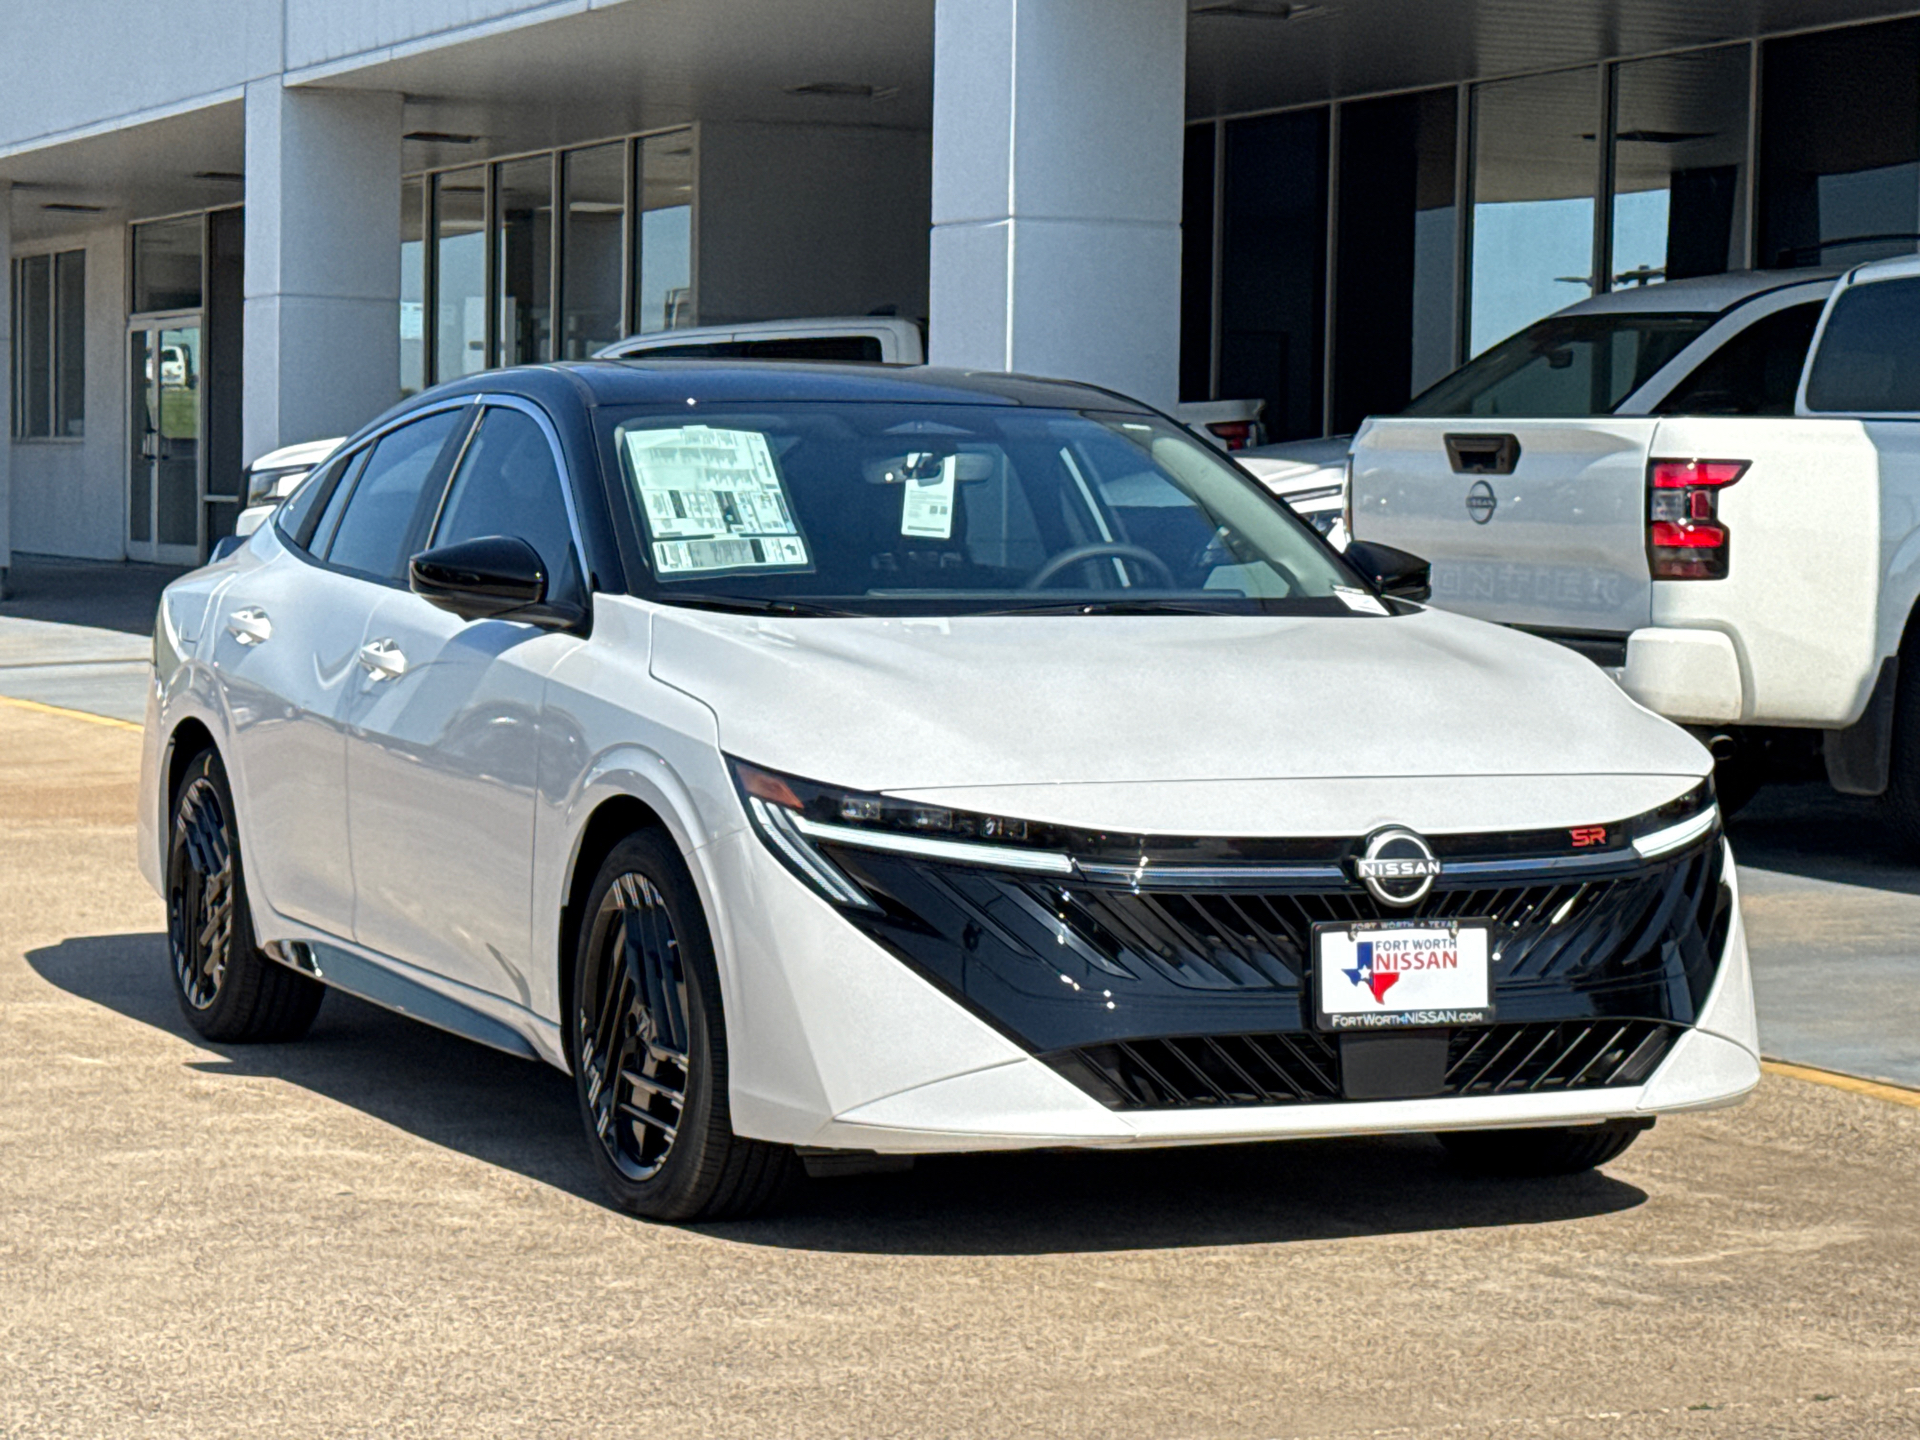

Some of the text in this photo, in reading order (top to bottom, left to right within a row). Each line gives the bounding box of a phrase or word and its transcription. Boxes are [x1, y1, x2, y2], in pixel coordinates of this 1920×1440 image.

[1436, 565, 1621, 605] ONTIER
[1571, 827, 1606, 847] SR
[1360, 861, 1440, 876] NISSAN
[1351, 920, 1458, 931] FORT WORTH TEXAS
[1375, 938, 1457, 951] FORT WORTH
[1375, 950, 1458, 971] NISSAN
